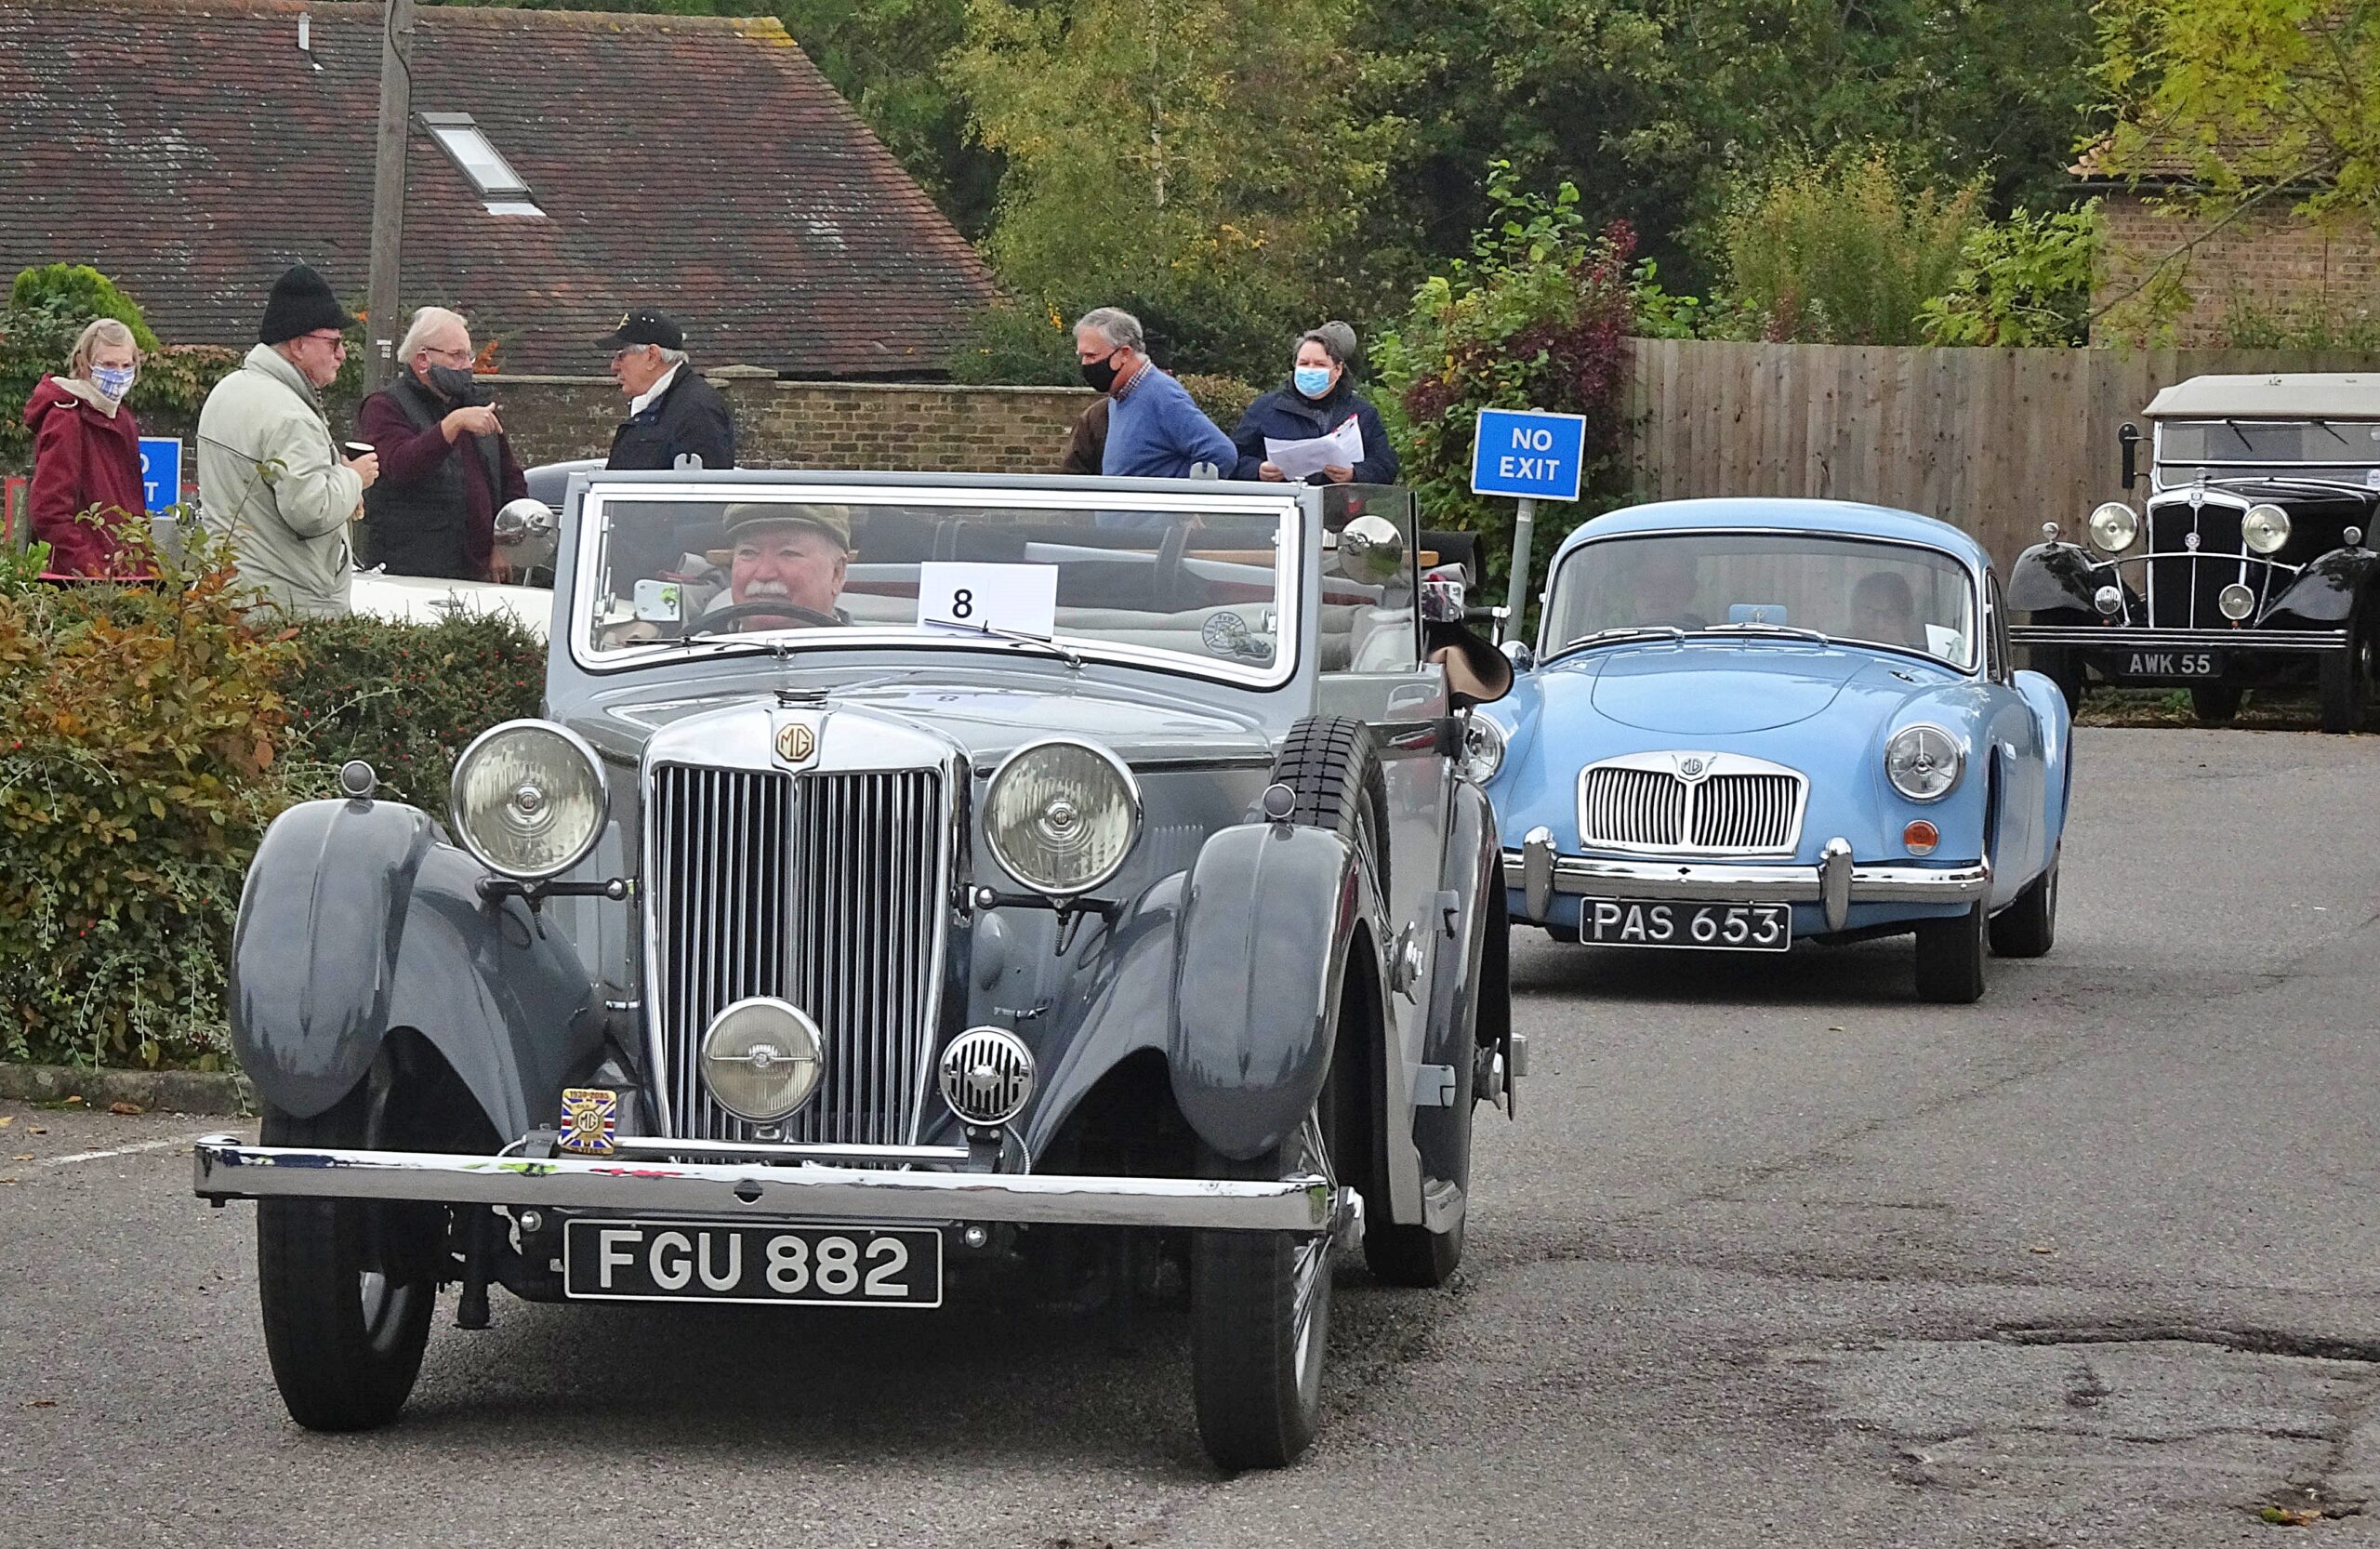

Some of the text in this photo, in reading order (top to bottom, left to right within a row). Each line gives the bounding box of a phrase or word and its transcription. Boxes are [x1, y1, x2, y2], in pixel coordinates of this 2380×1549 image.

[1512, 428, 1553, 452] NO
[1499, 456, 1560, 481] EXIT
[952, 589, 972, 618] 8
[2129, 653, 2211, 674] AWK 55
[779, 726, 811, 759] MG
[1683, 758, 1701, 773] MG
[1593, 902, 1779, 944] PAS 653
[579, 1111, 598, 1130] MG
[600, 1229, 909, 1297] FGU 882
